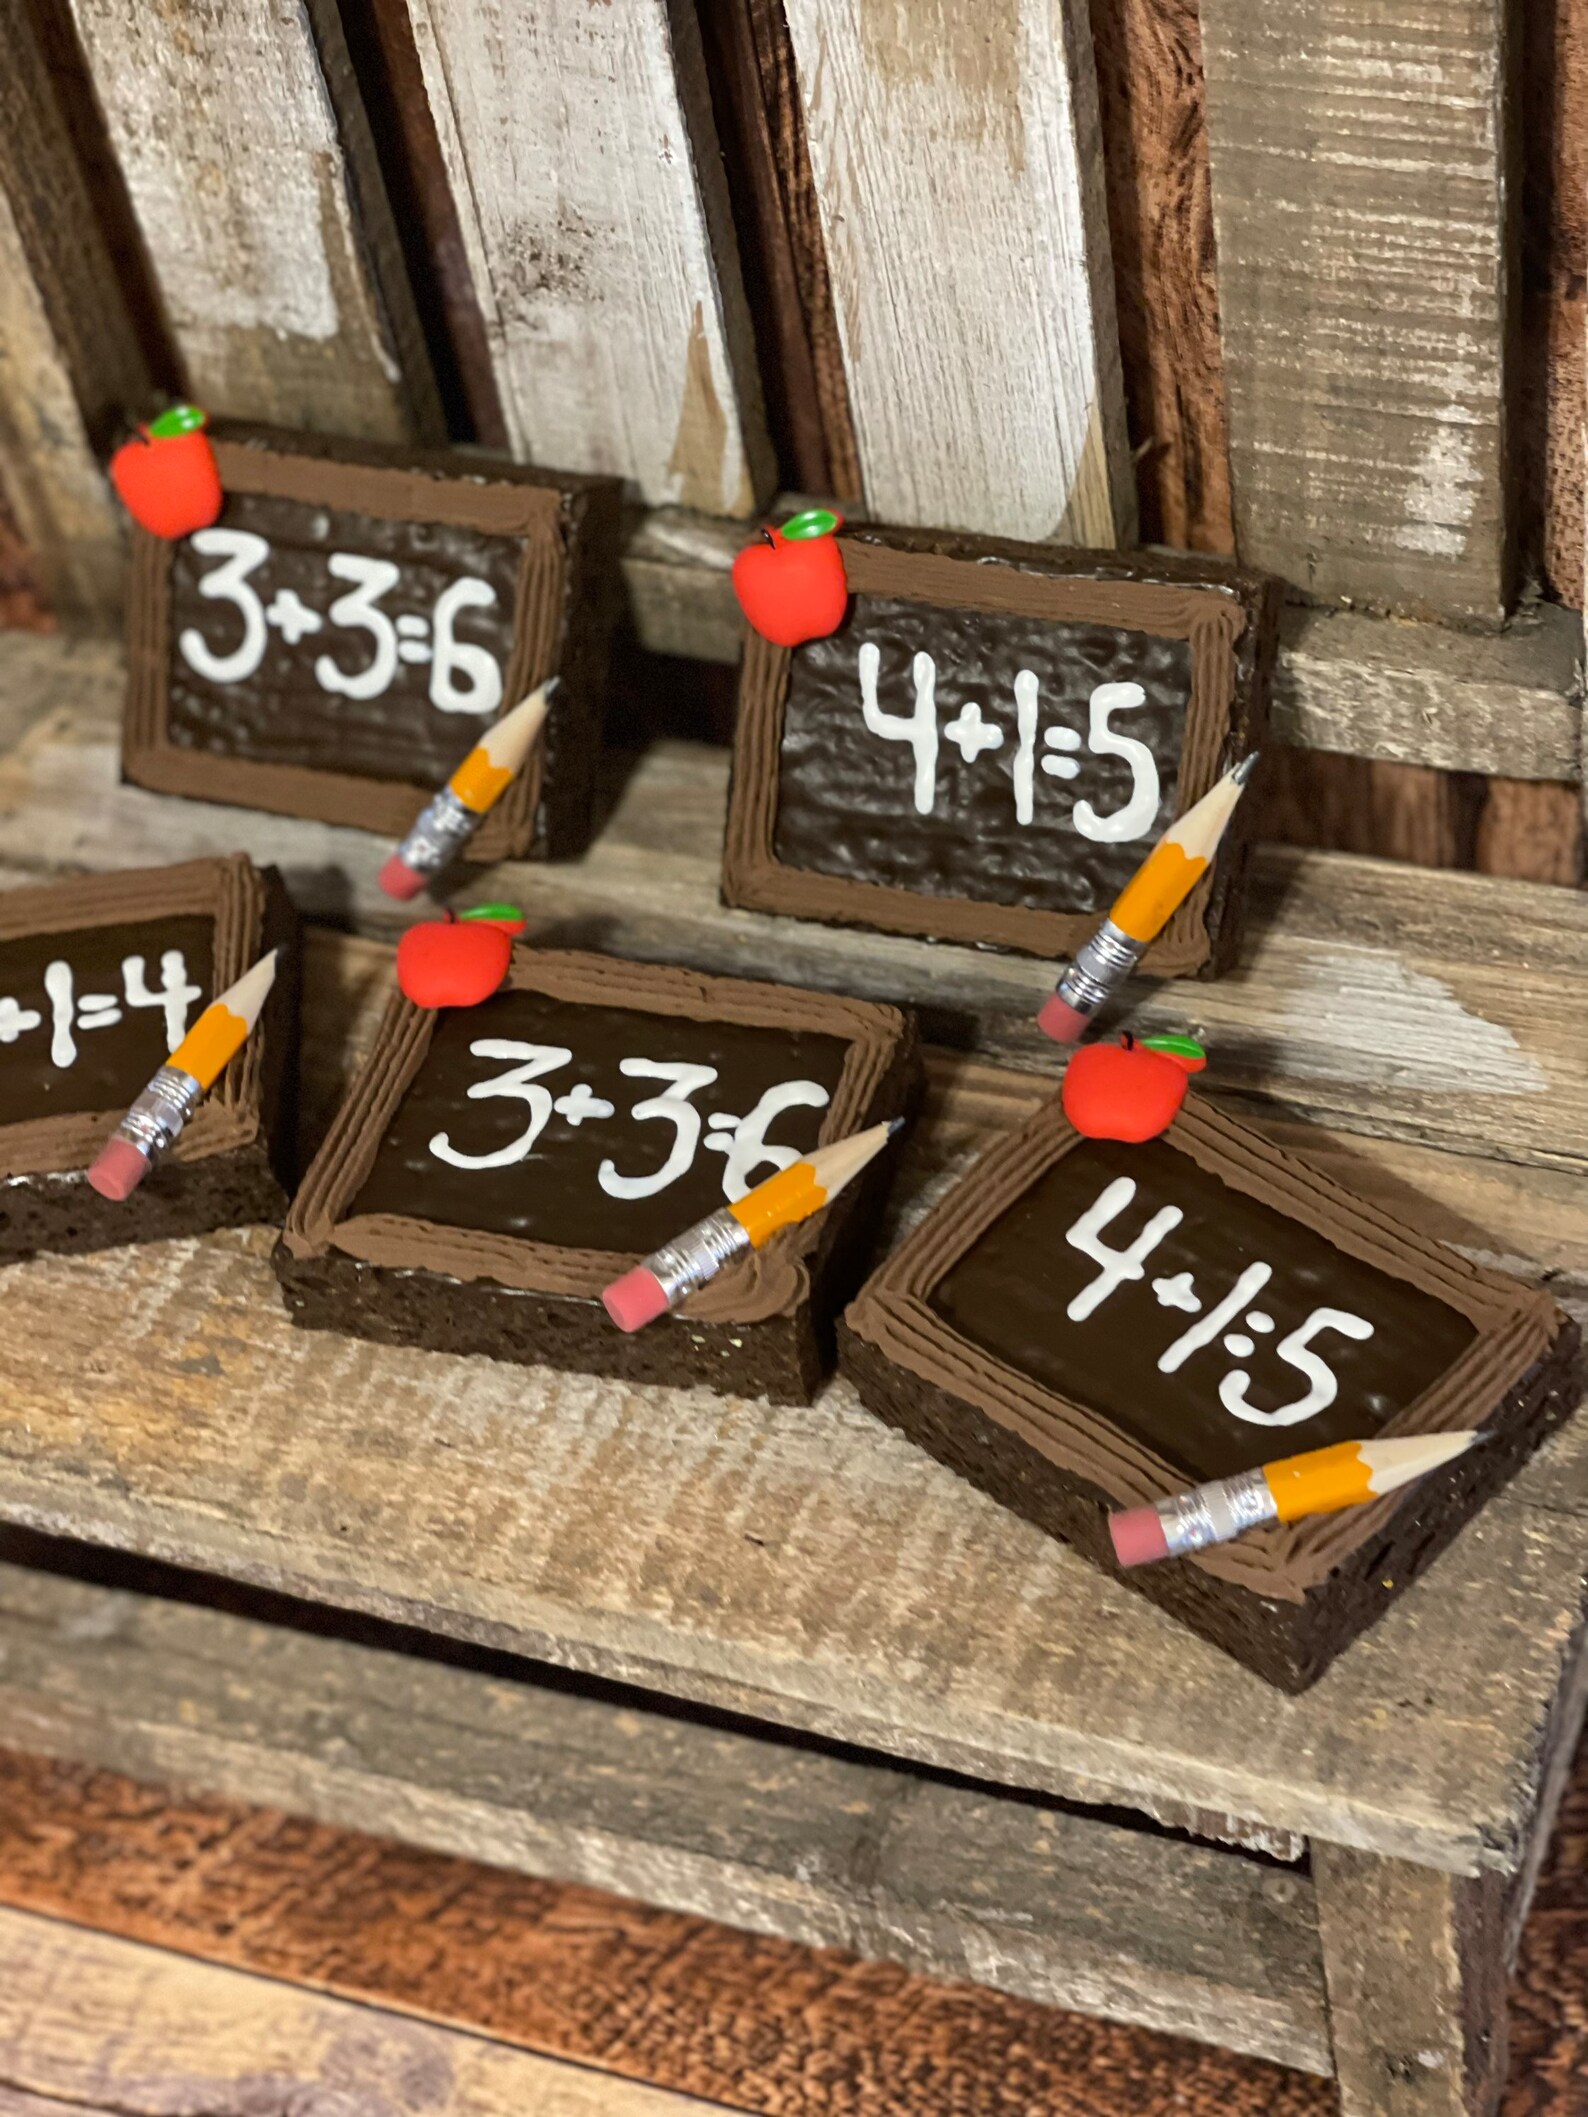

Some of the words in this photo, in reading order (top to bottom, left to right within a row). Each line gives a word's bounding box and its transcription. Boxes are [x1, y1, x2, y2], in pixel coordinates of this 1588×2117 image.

[179, 528, 504, 715] 3+3=6
[857, 641, 1162, 844] 4+1=5
[428, 1038, 830, 1204] 3+3=6
